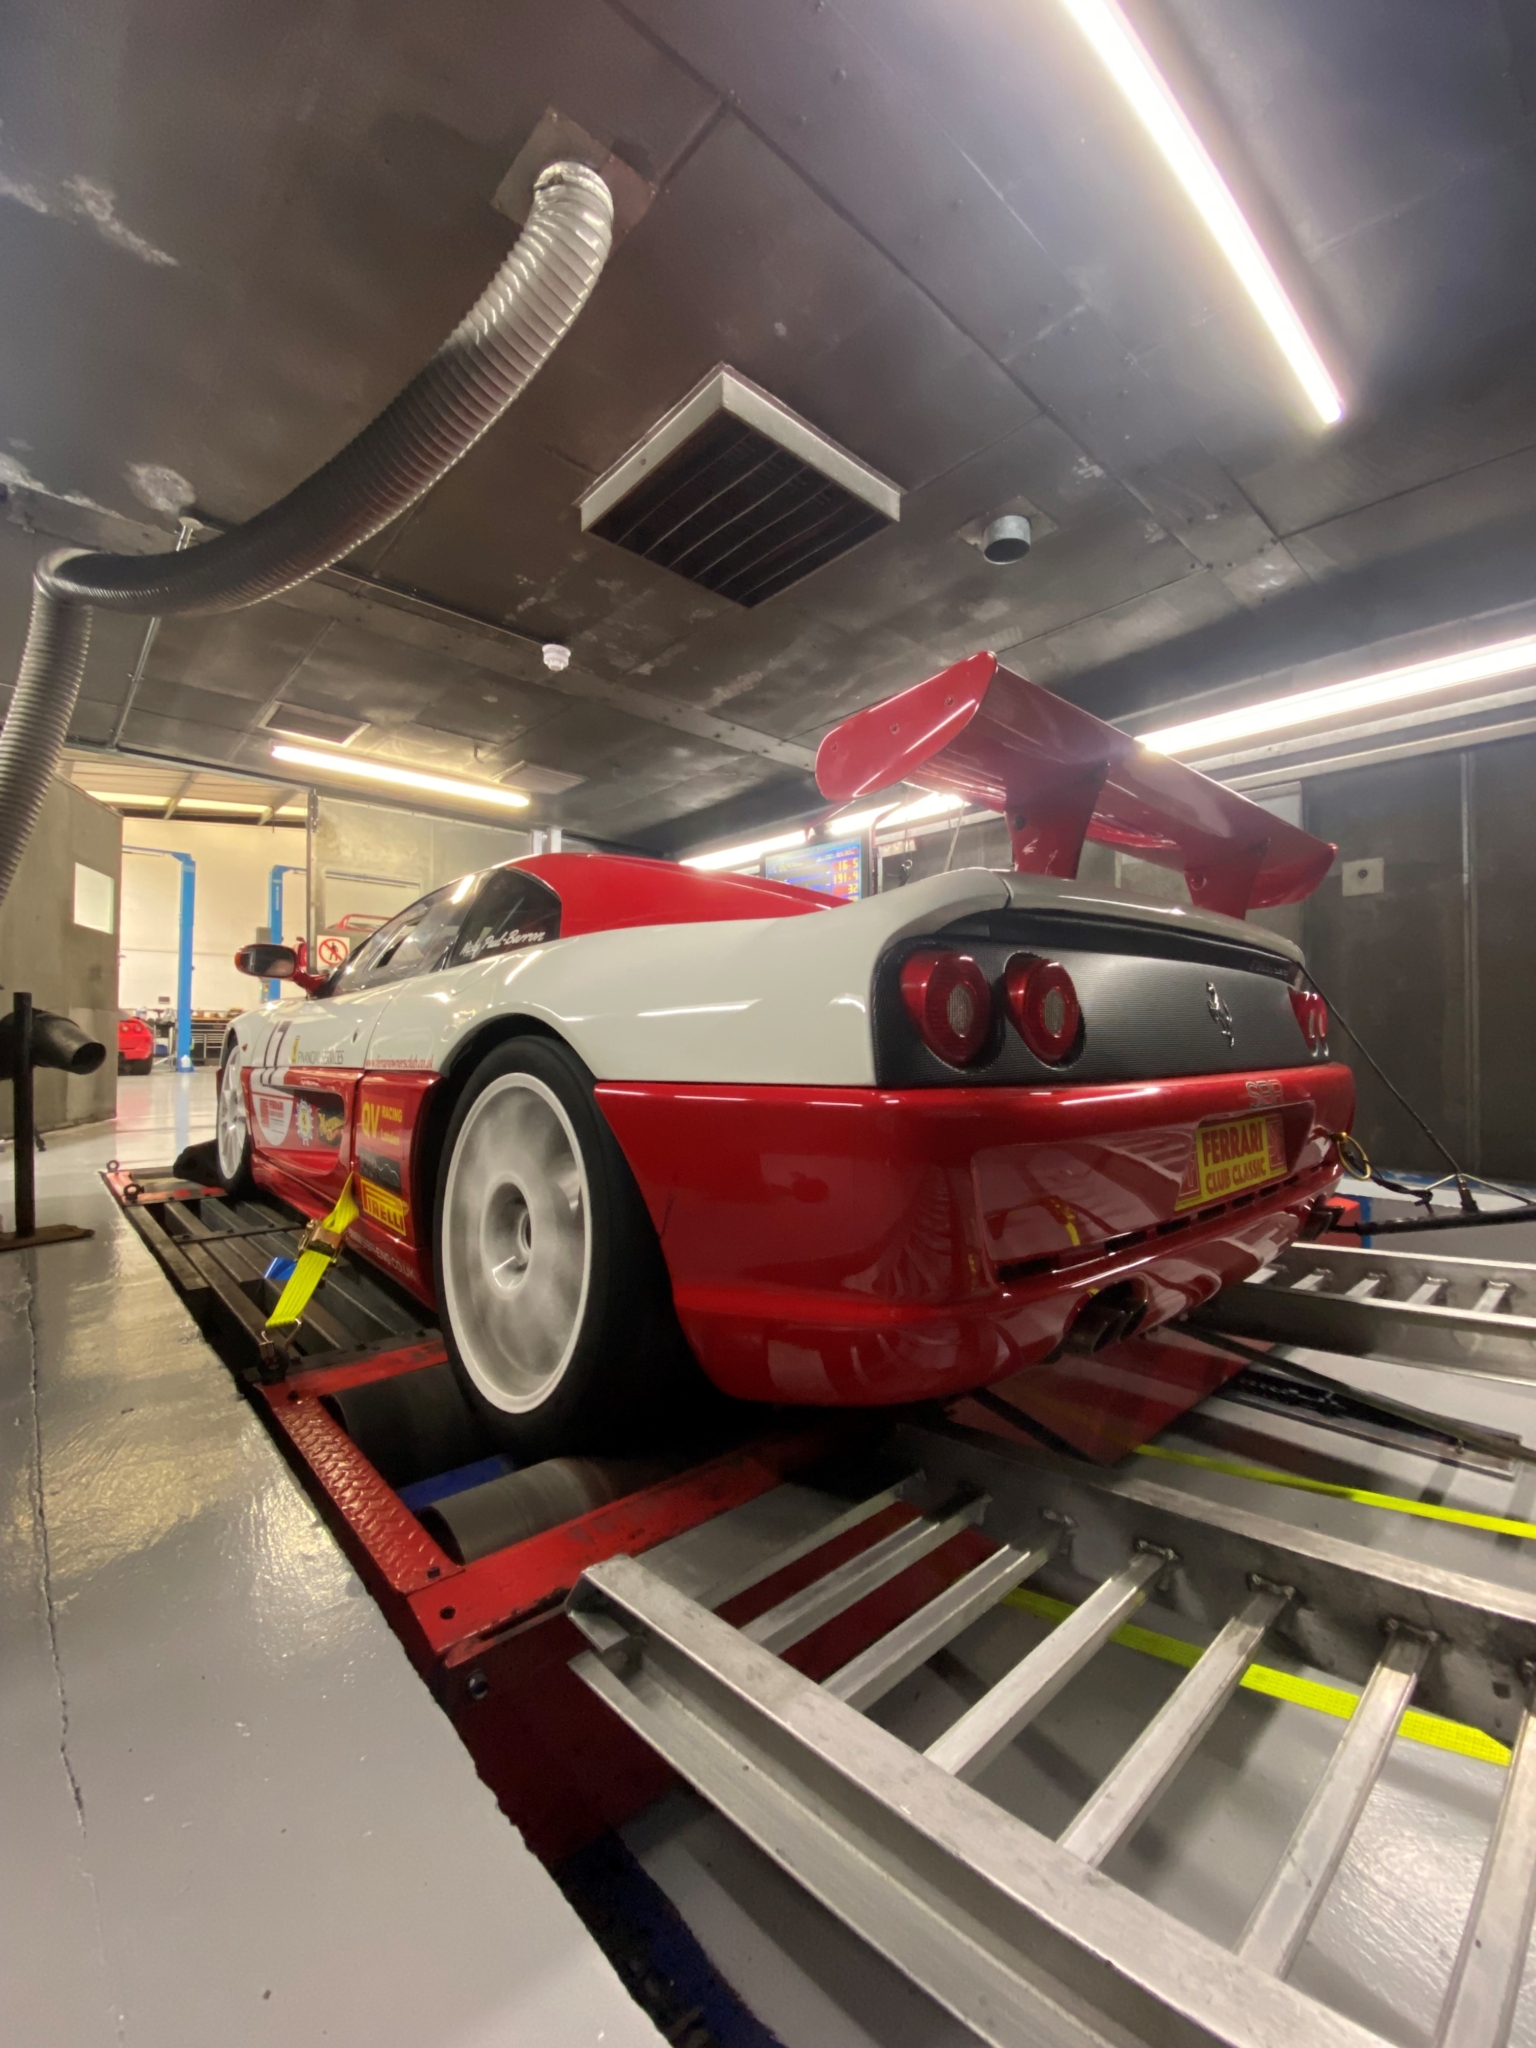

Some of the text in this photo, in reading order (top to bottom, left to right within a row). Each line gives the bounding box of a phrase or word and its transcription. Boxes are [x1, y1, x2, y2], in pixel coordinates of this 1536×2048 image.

[361, 1101, 381, 1139] QV
[381, 1105, 403, 1123] RACING
[1201, 1121, 1264, 1167] FERRARI
[1205, 1157, 1267, 1195] CLUB CLASSIC
[360, 1178, 410, 1236] PIRELLI
